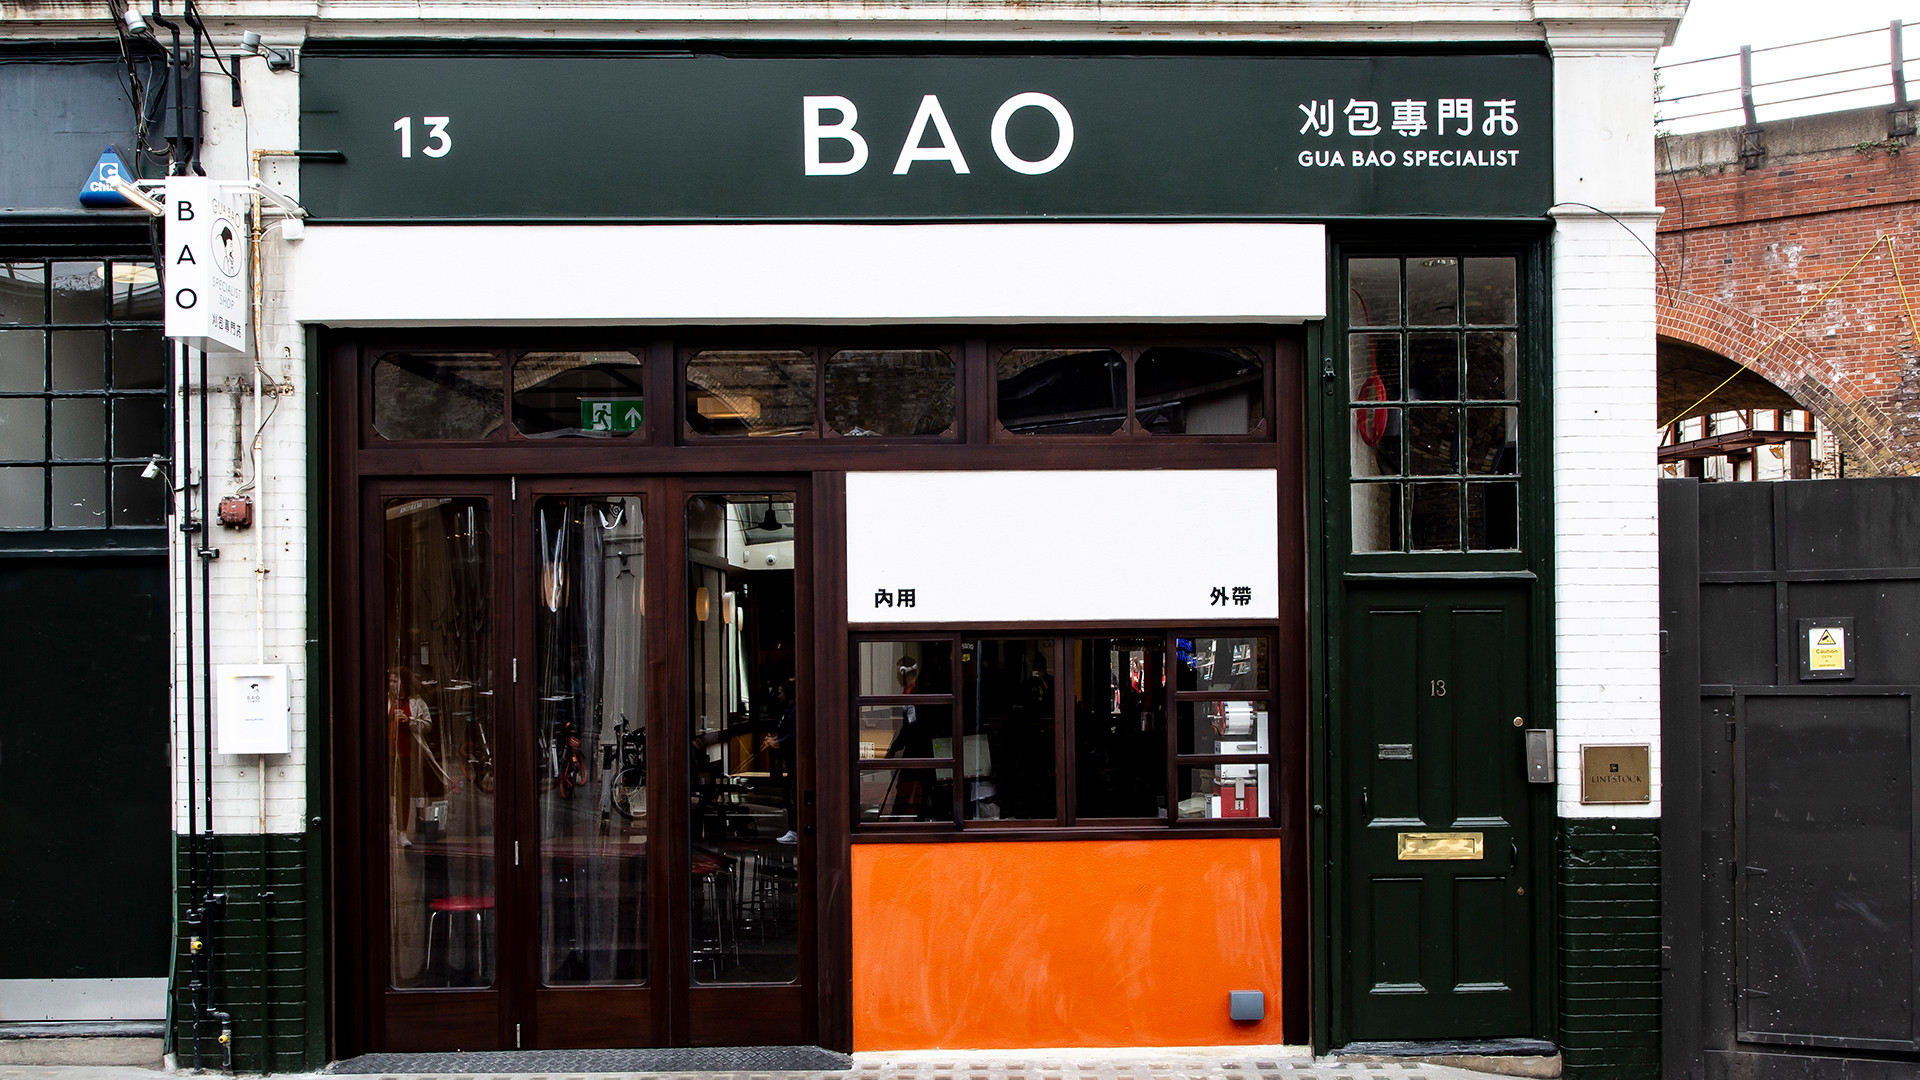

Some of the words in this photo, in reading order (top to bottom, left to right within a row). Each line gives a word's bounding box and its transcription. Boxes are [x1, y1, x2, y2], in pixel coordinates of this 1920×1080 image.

[393, 116, 452, 158] 13
[802, 91, 1075, 176] BAO
[1298, 150, 1345, 167] GUA
[1352, 150, 1397, 167] BAO
[1402, 150, 1520, 167] SPECIALIST
[212, 198, 227, 216] GUA
[227, 206, 241, 228] BAO
[175, 200, 198, 310] BAO
[212, 276, 241, 299] SPECIALIST
[219, 294, 235, 309] SHOP
[1209, 586, 1252, 606] 外帶
[1430, 679, 1447, 697] 13
[1591, 774, 1642, 784] LINTSTOCK
